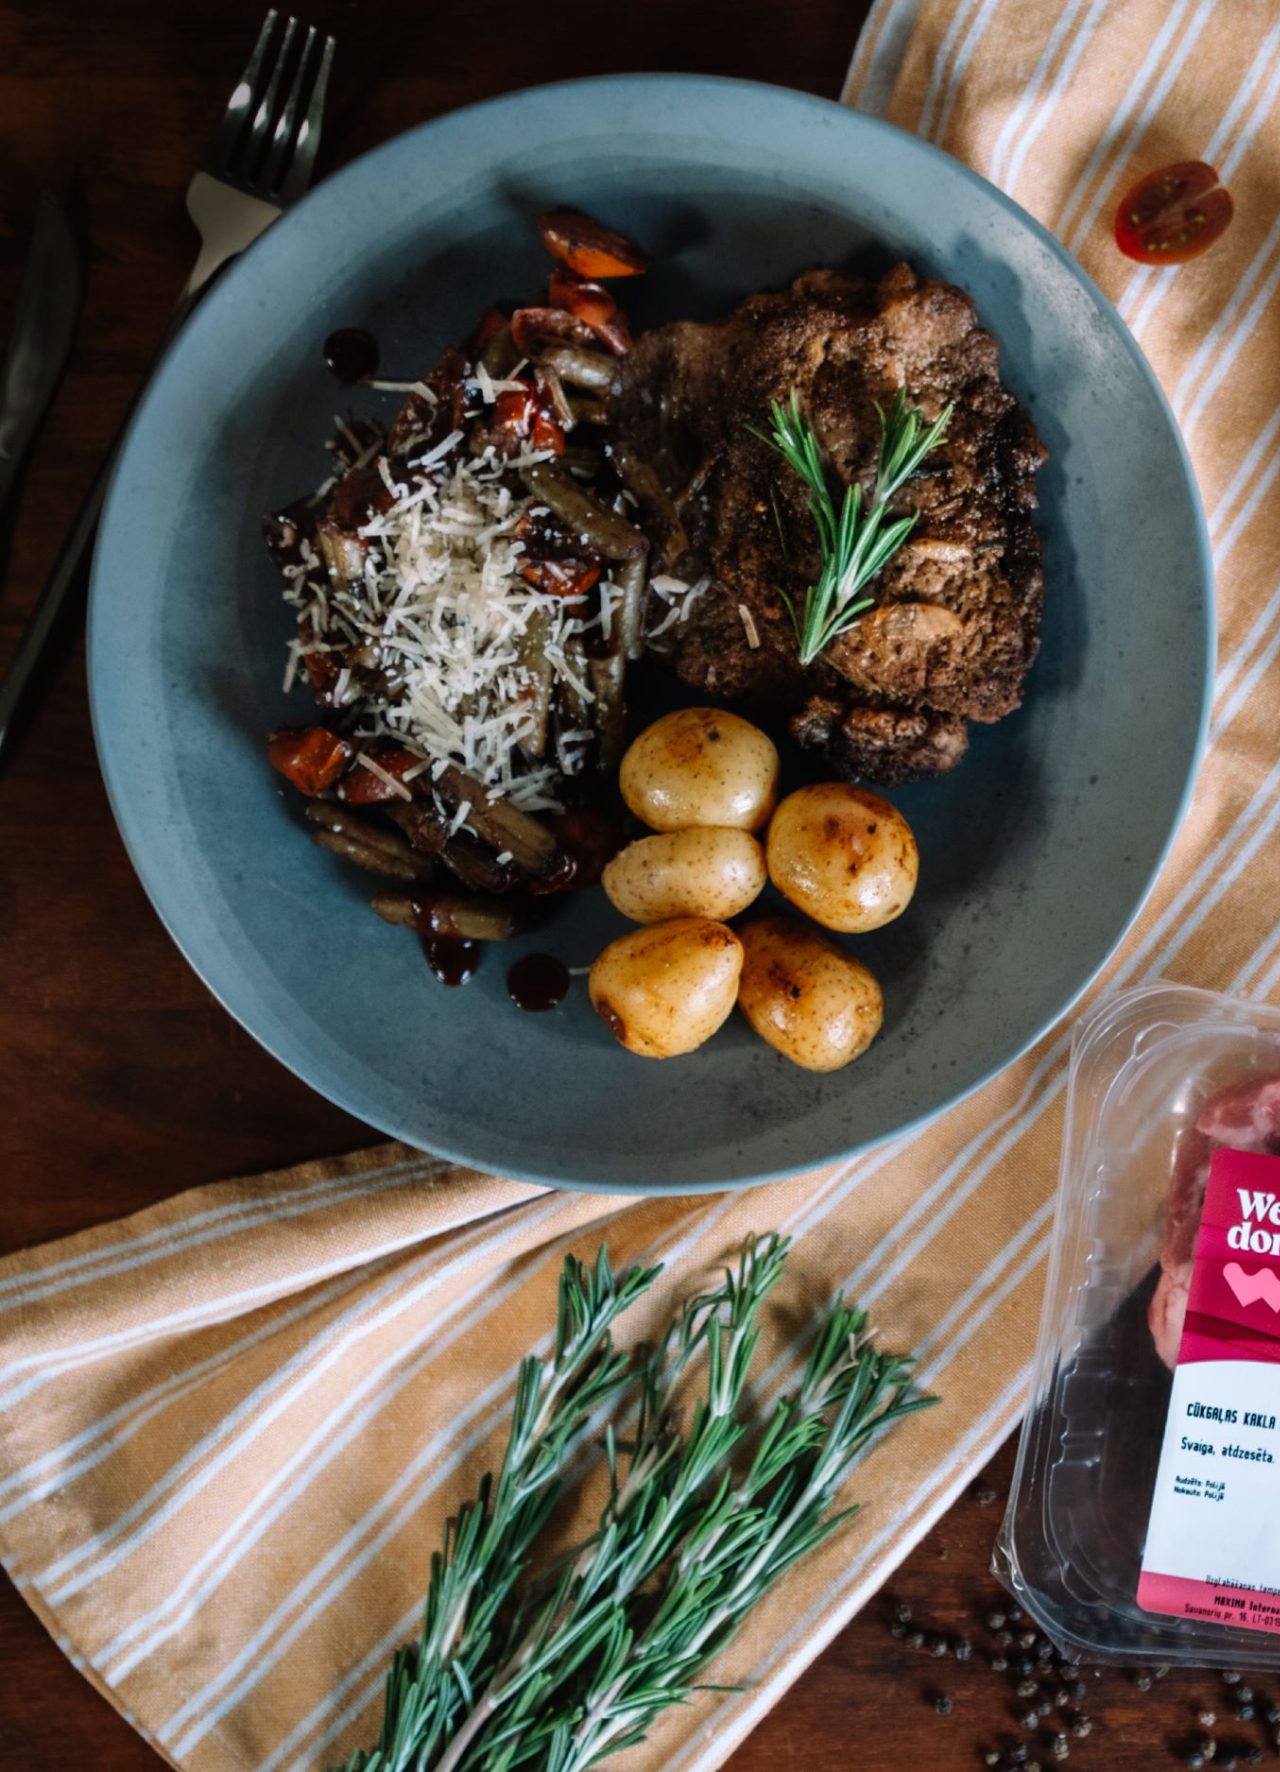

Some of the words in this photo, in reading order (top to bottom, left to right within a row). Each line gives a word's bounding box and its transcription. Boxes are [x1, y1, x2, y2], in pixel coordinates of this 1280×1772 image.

[1186, 1402, 1238, 1425] CŪKGAĻAS
[1243, 1412, 1276, 1430] KAKLA
[1181, 1437, 1216, 1456] Svaiga,
[1221, 1444, 1275, 1464] atdzesēta.
